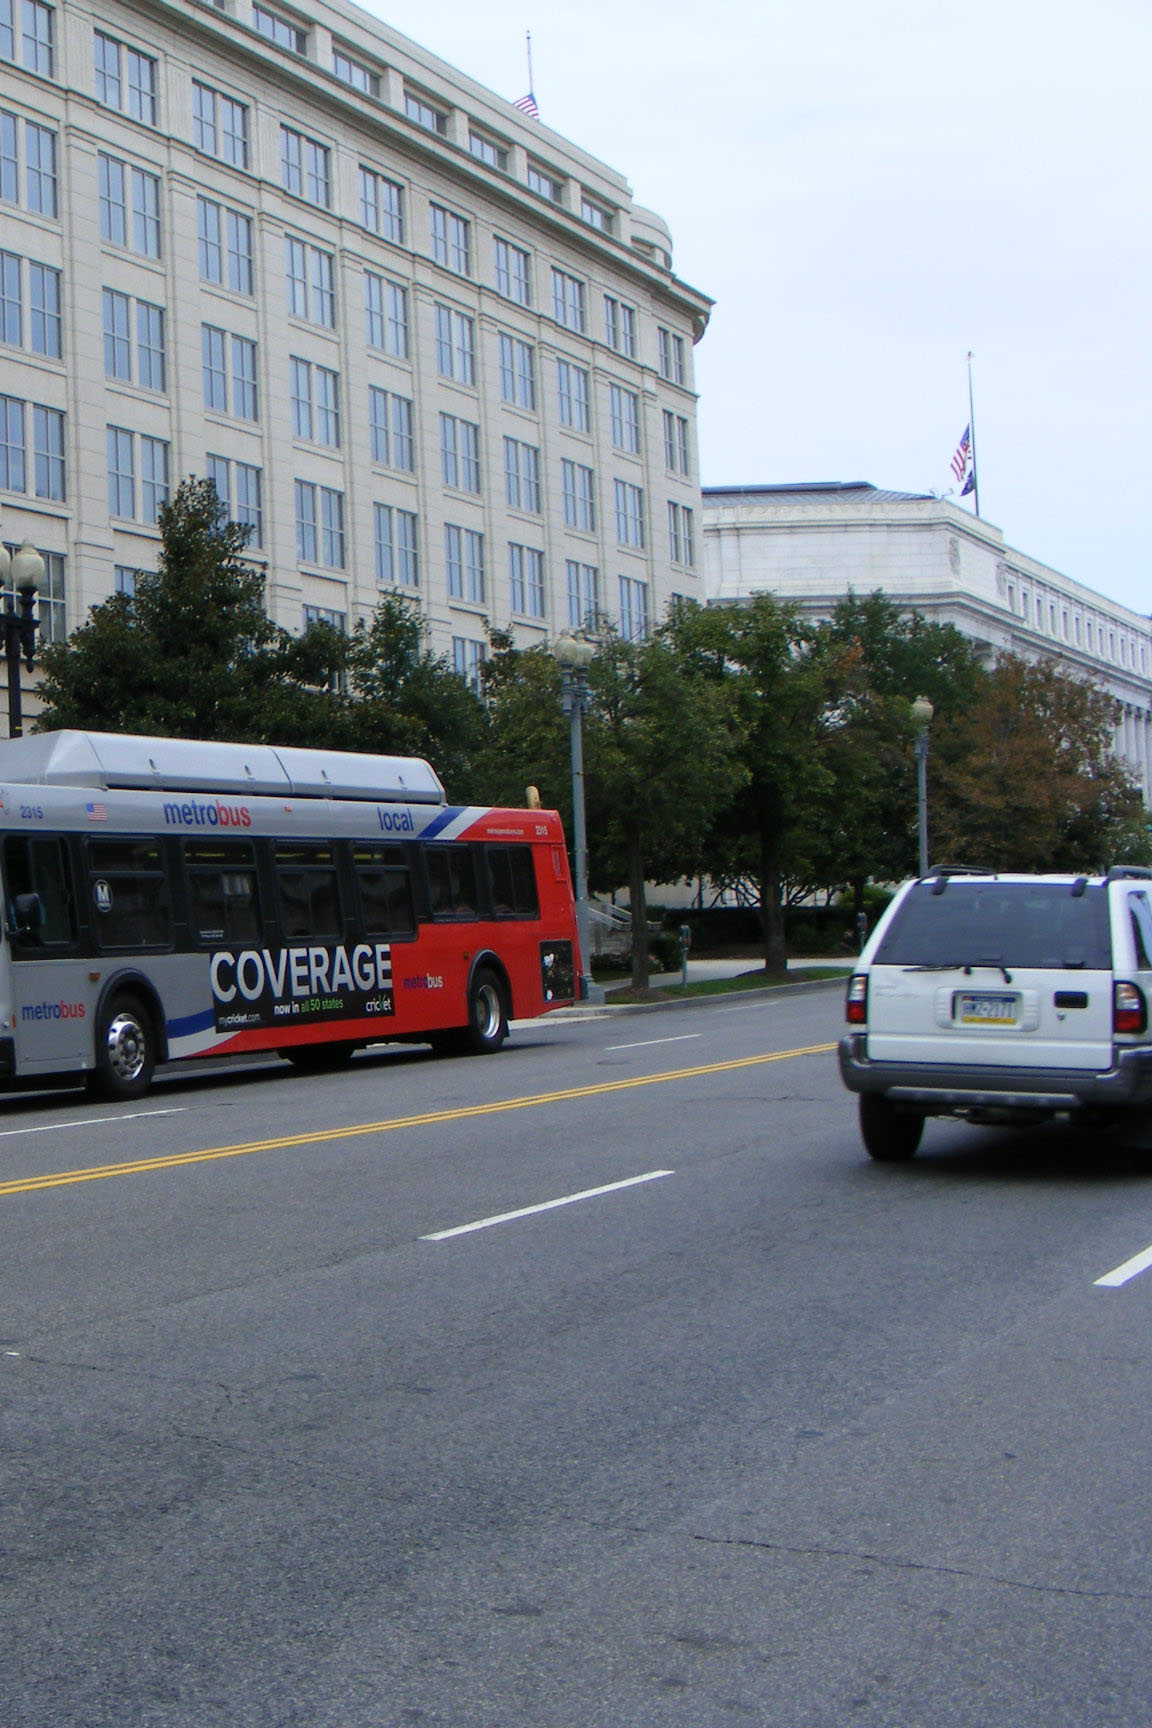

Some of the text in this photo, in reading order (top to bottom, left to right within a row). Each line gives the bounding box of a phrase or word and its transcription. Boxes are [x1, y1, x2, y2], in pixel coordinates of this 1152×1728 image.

[20, 805, 44, 820] 2315
[163, 799, 252, 827] metrobus
[377, 806, 415, 832] local
[210, 943, 394, 1003] COVERAGE
[404, 972, 444, 989] metrobus
[21, 1000, 86, 1020] metrobus
[274, 998, 345, 1016] now in all 50 states
